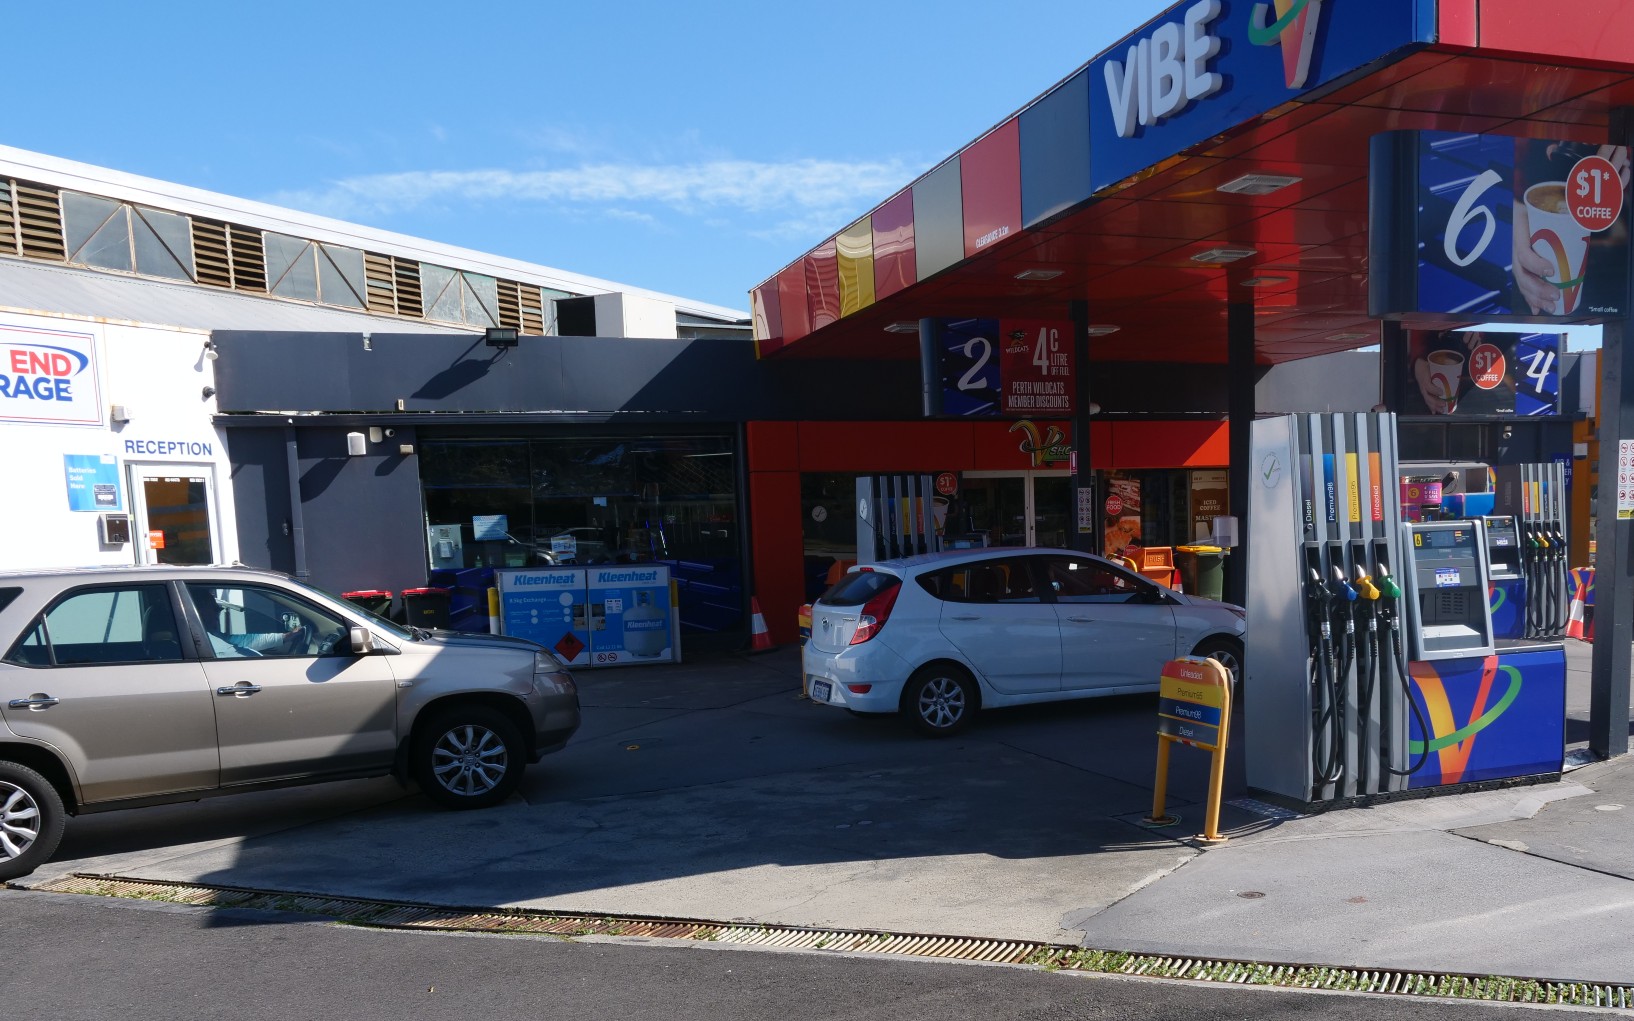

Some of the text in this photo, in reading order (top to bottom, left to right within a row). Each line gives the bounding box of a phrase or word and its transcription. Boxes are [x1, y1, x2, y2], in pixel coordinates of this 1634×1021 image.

[1104, 0, 1222, 138] VIBE
[1443, 169, 1503, 267] 6
[1577, 206, 1611, 220] COFFEE
[1006, 345, 1030, 353] WILDCATS
[1033, 327, 1049, 376] 4
[10, 350, 72, 377] END
[957, 337, 992, 391] 2
[1051, 353, 1068, 366] LITRE
[1059, 366, 1070, 376] FUEL
[1526, 349, 1556, 394] 4
[1476, 374, 1499, 382] COFFEE
[1012, 381, 1065, 394] PERTH WILDCATS
[1008, 396, 1070, 408] MEMBER DISCOUNTS
[124, 439, 213, 456] RECEPTION
[1415, 535, 1421, 546] 6
[513, 573, 576, 586] Kleenheat
[598, 570, 658, 583] Kleenheat
[627, 620, 663, 629] Kleenheat
[1180, 668, 1203, 680] Unleaded
[1177, 687, 1203, 700] Premium95
[1175, 705, 1202, 719] Premium98
[1178, 726, 1194, 737] Diesel
